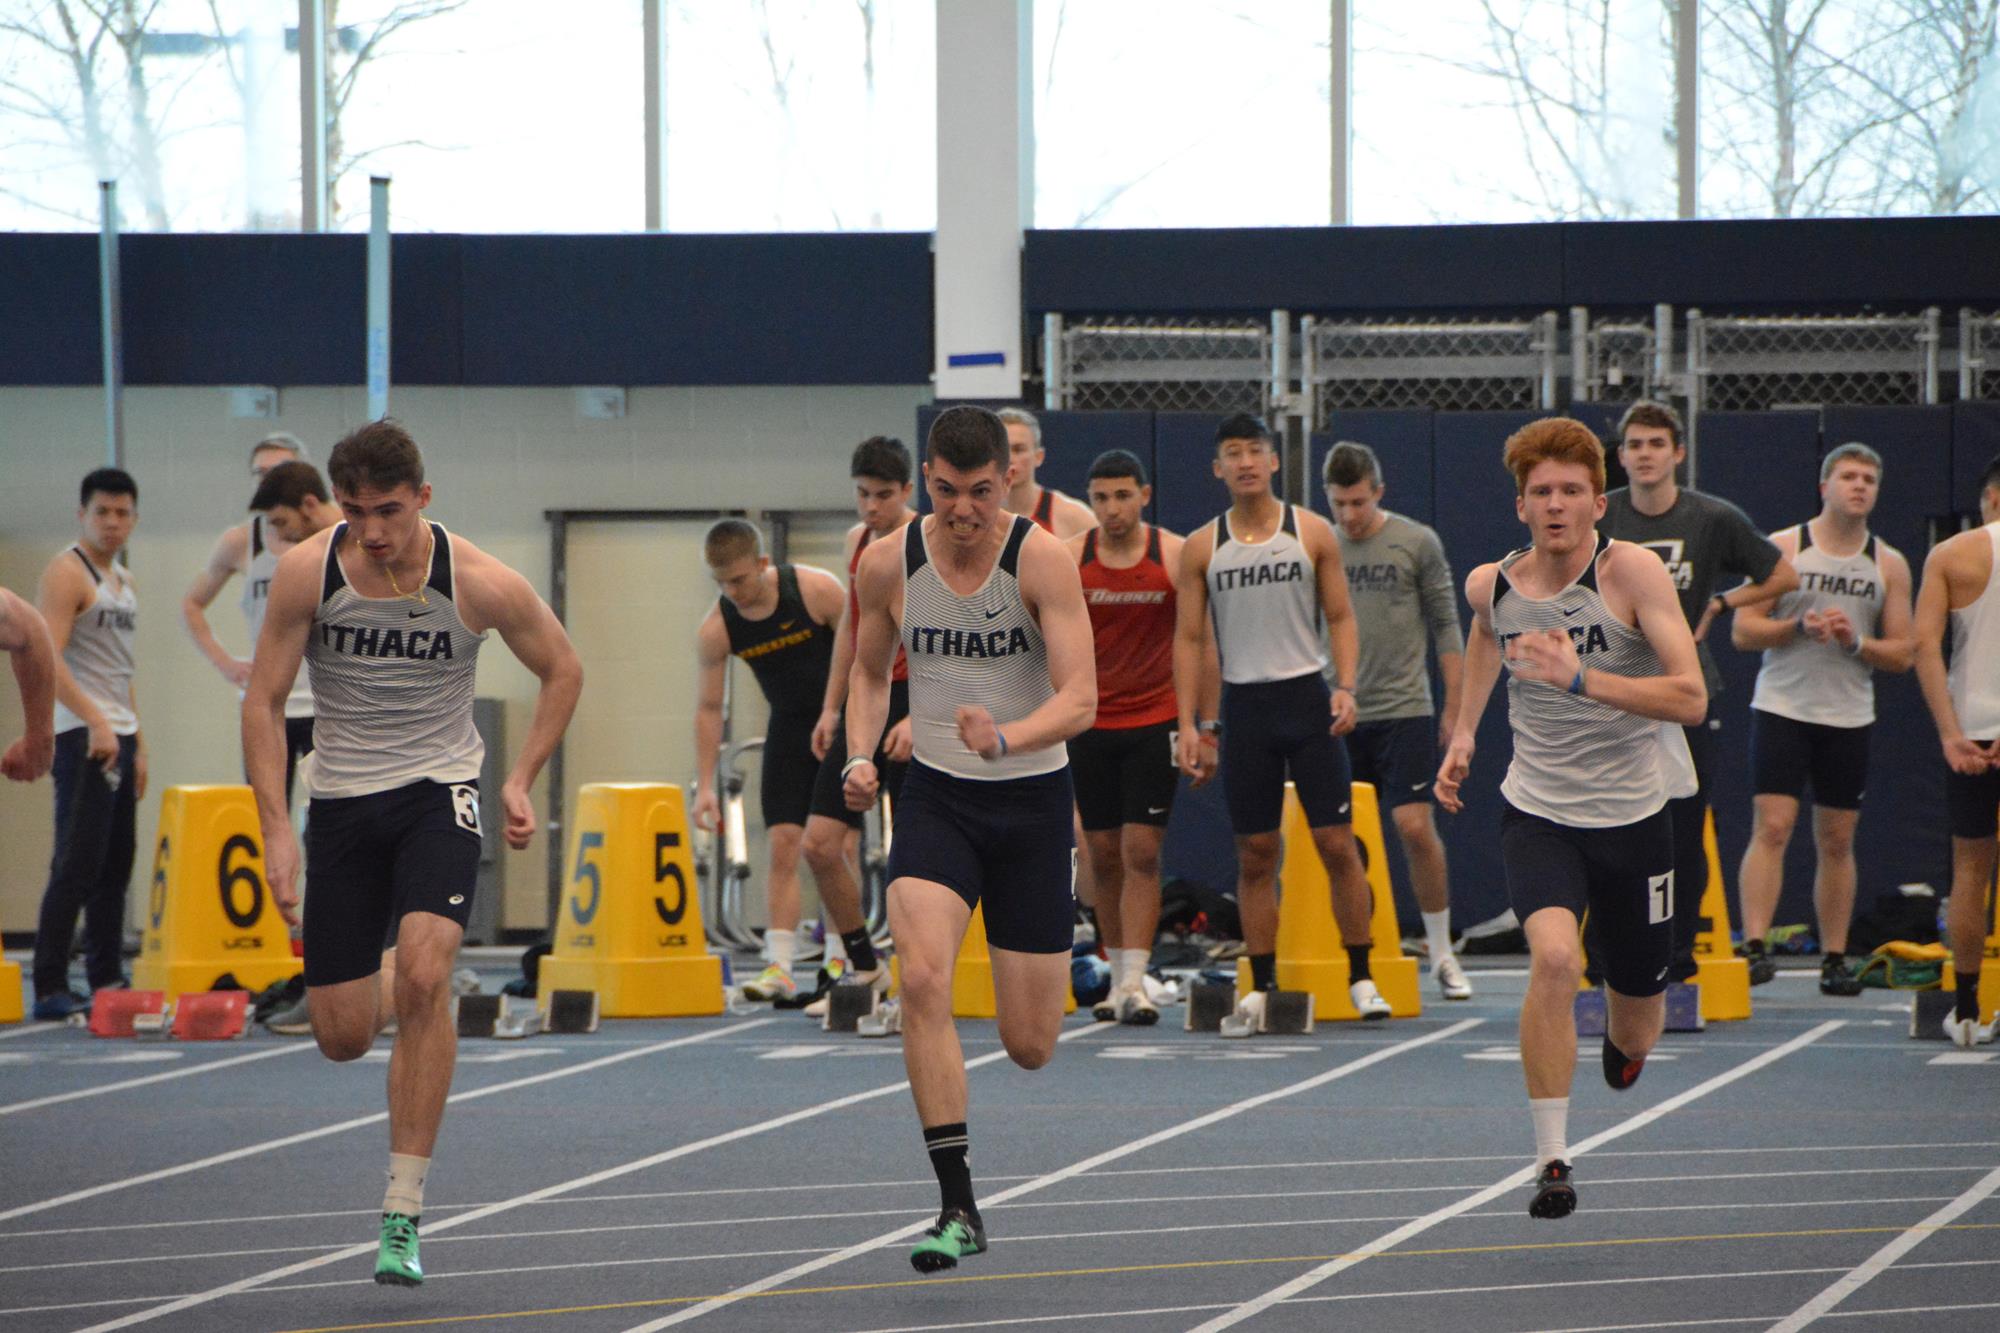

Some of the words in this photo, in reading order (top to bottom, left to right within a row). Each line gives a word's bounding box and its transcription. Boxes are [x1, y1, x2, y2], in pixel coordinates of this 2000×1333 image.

[1216, 562, 1303, 592] ITHACA
[1801, 571, 1876, 600] THACA
[322, 622, 453, 660] ITHACA
[912, 626, 1031, 658] ITHACA
[457, 787, 478, 829] 3
[218, 833, 263, 929] 6
[571, 832, 605, 925] 5
[654, 832, 687, 926] 5
[1655, 877, 1669, 919] 1
